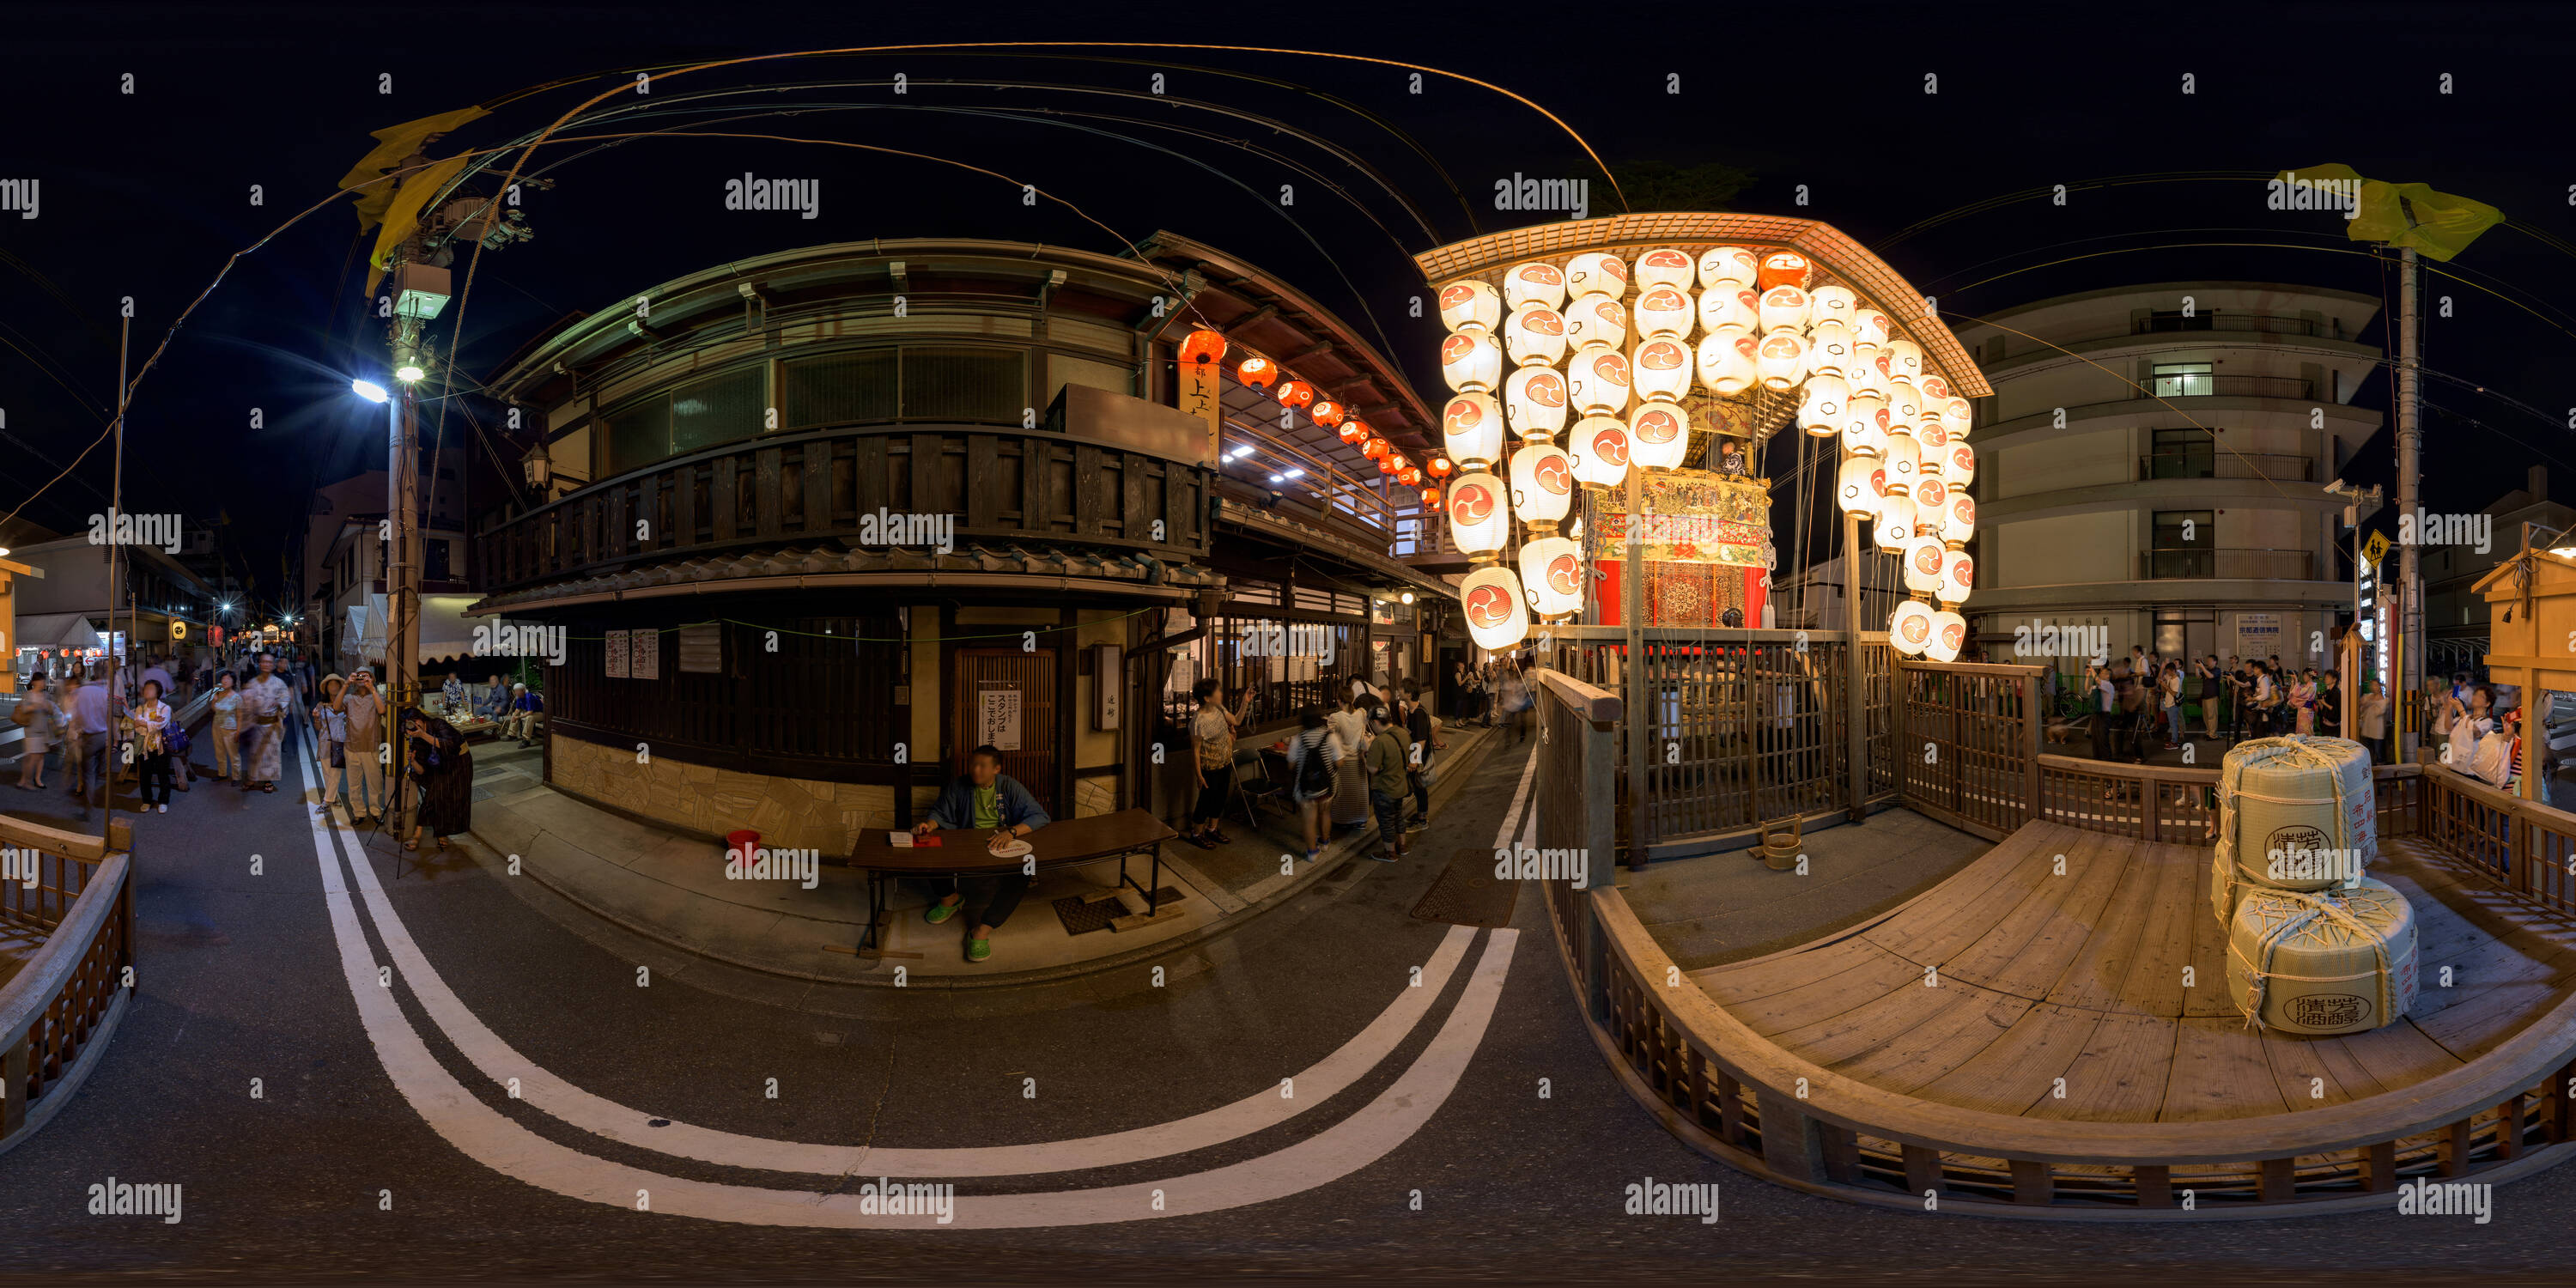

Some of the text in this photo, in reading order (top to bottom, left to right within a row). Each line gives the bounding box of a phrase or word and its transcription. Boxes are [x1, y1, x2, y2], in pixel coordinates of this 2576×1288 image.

[997, 695, 1006, 732] スタンプは
